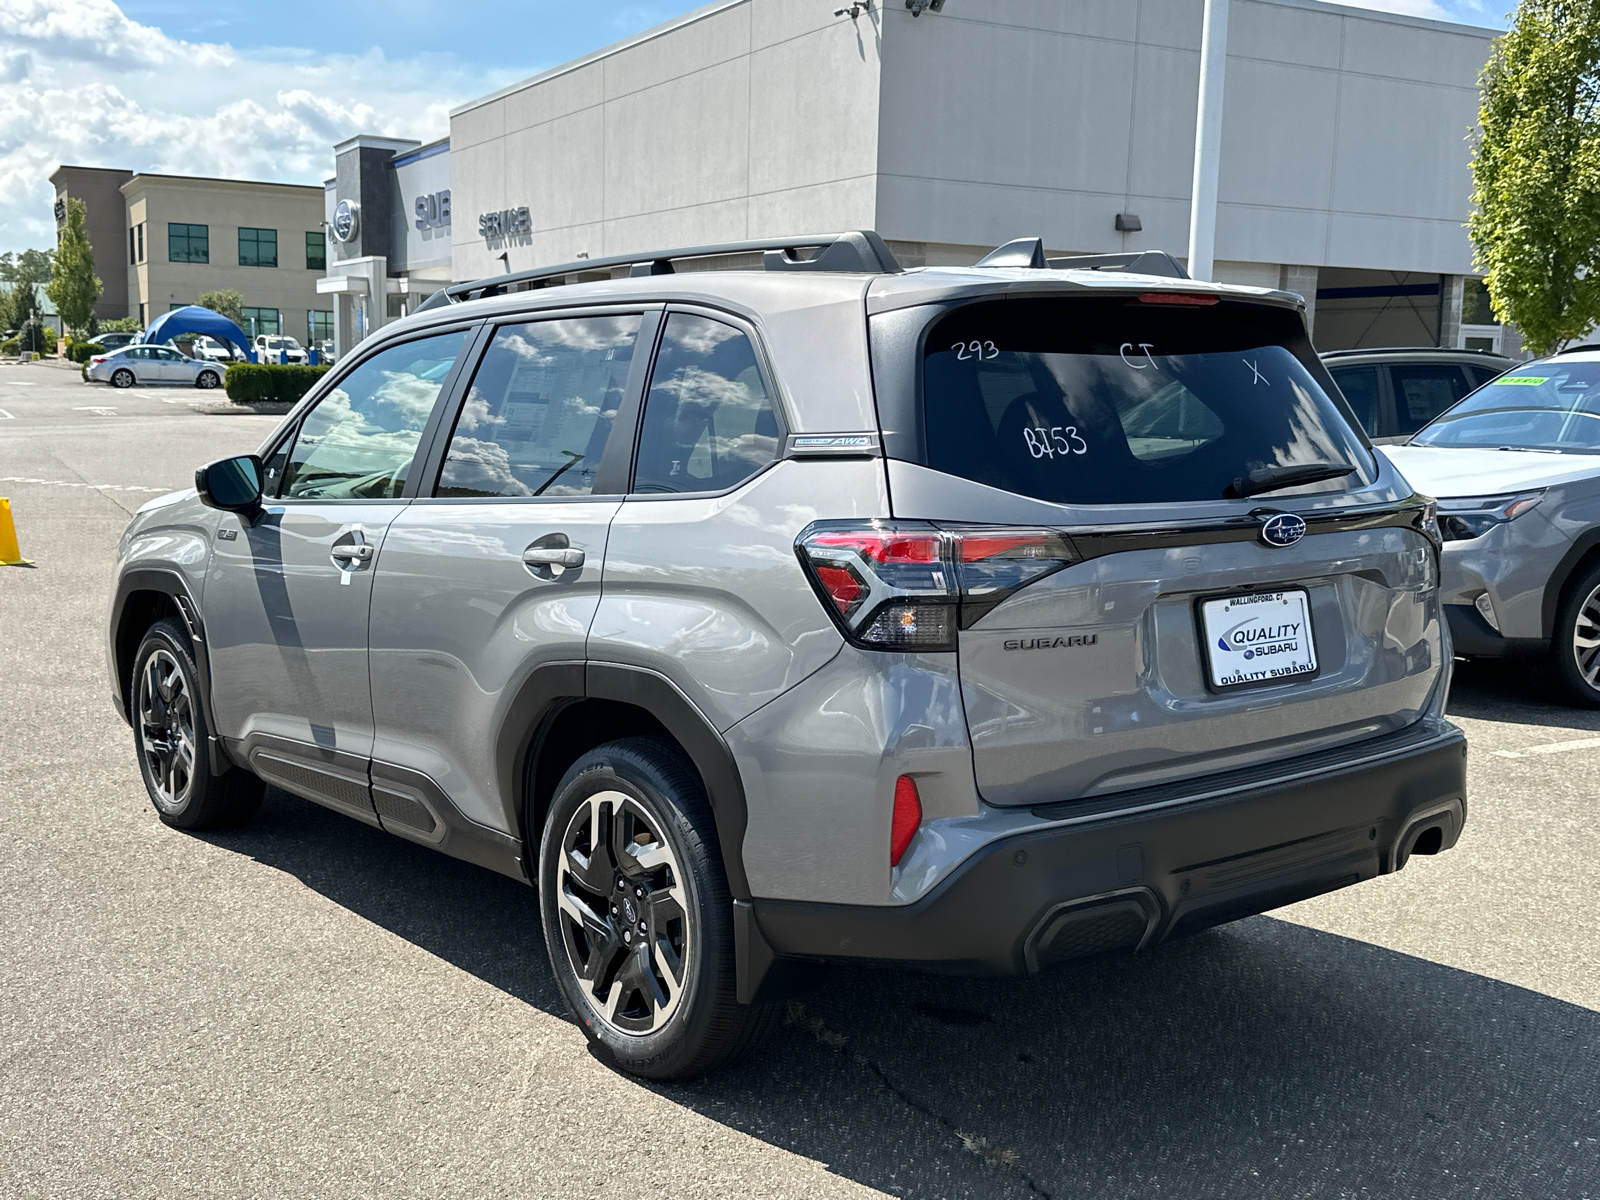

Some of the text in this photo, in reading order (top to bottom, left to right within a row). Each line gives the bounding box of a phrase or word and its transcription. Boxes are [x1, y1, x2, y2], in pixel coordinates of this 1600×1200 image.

[479, 206, 531, 236] SERVICE
[951, 340, 999, 360] 293
[1119, 343, 1158, 370] CT
[1276, 593, 1284, 601] CT
[1004, 634, 1098, 651] SUBARU
[1233, 623, 1300, 643] QUALITY
[1255, 642, 1298, 657] SUBARU
[1221, 663, 1314, 685] QUALITY SUBARU
